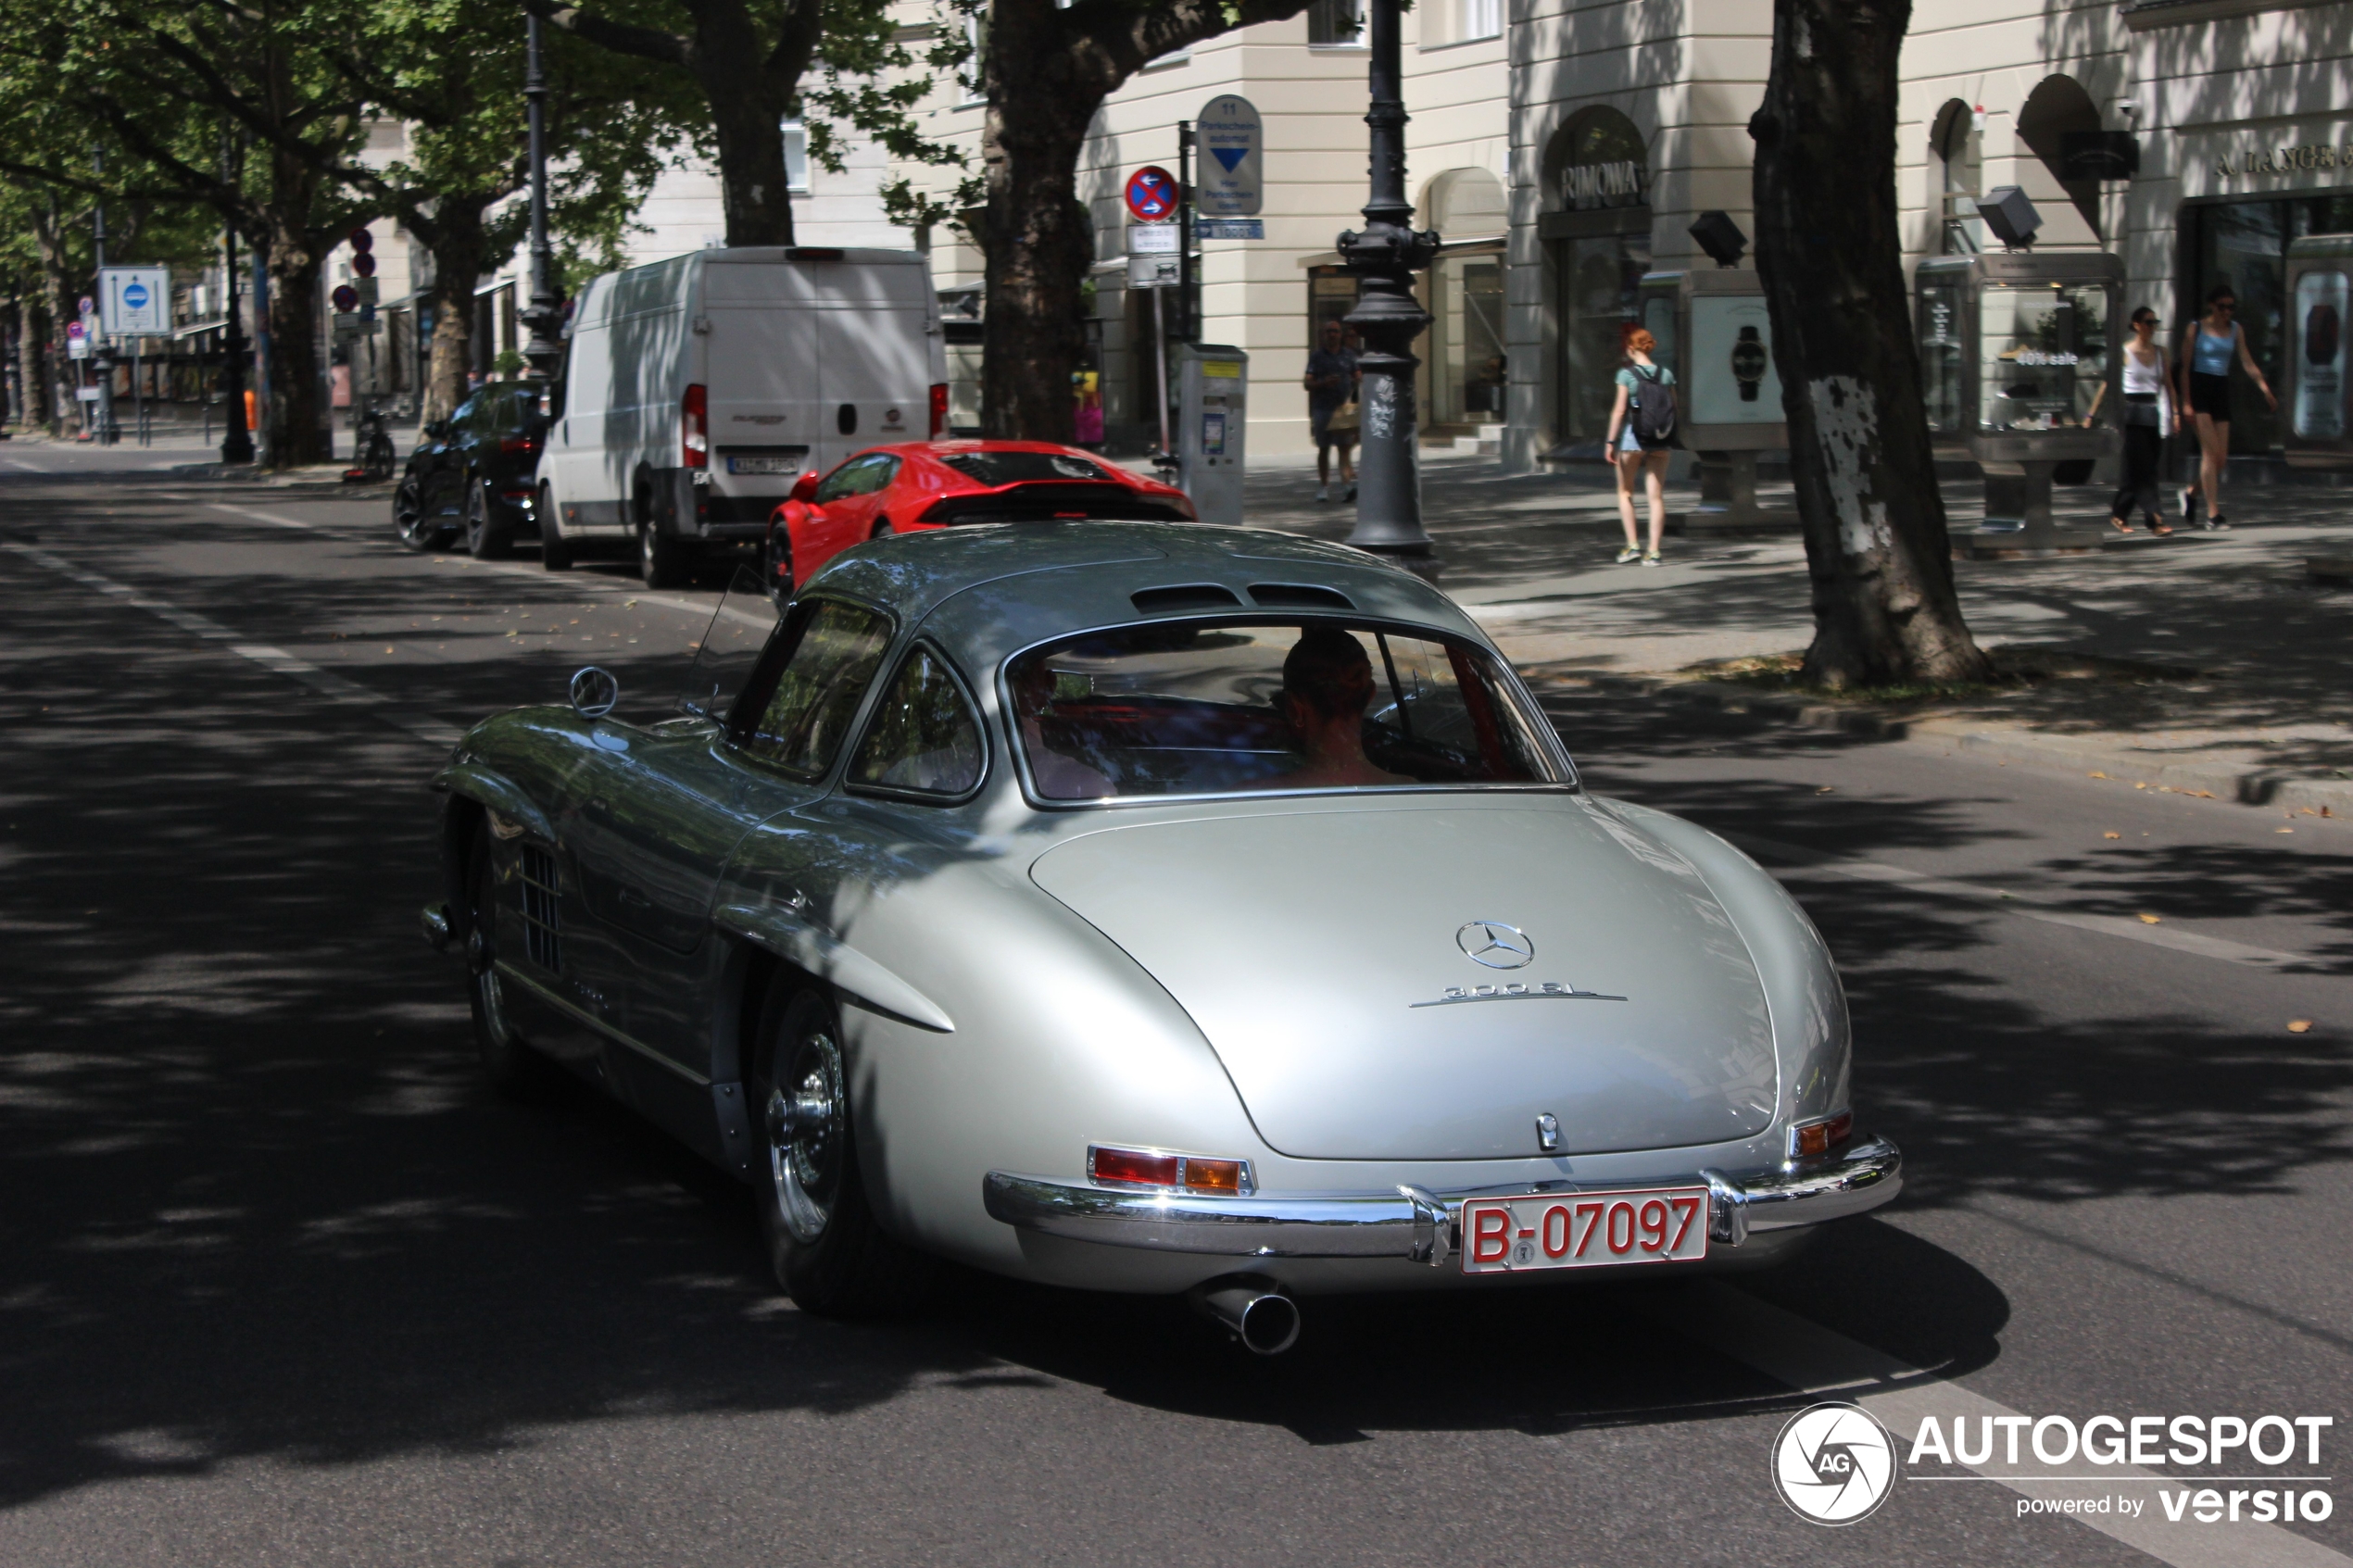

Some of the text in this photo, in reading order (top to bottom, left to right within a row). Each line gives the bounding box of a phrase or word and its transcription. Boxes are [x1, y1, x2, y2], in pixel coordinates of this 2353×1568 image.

[1222, 103, 1237, 116] 11
[2245, 144, 2335, 173] LANGE
[1561, 160, 1639, 199] RIMOWA
[2049, 350, 2079, 365] sale
[1443, 983, 1529, 999] 300
[1473, 1197, 1701, 1264] B-07097
